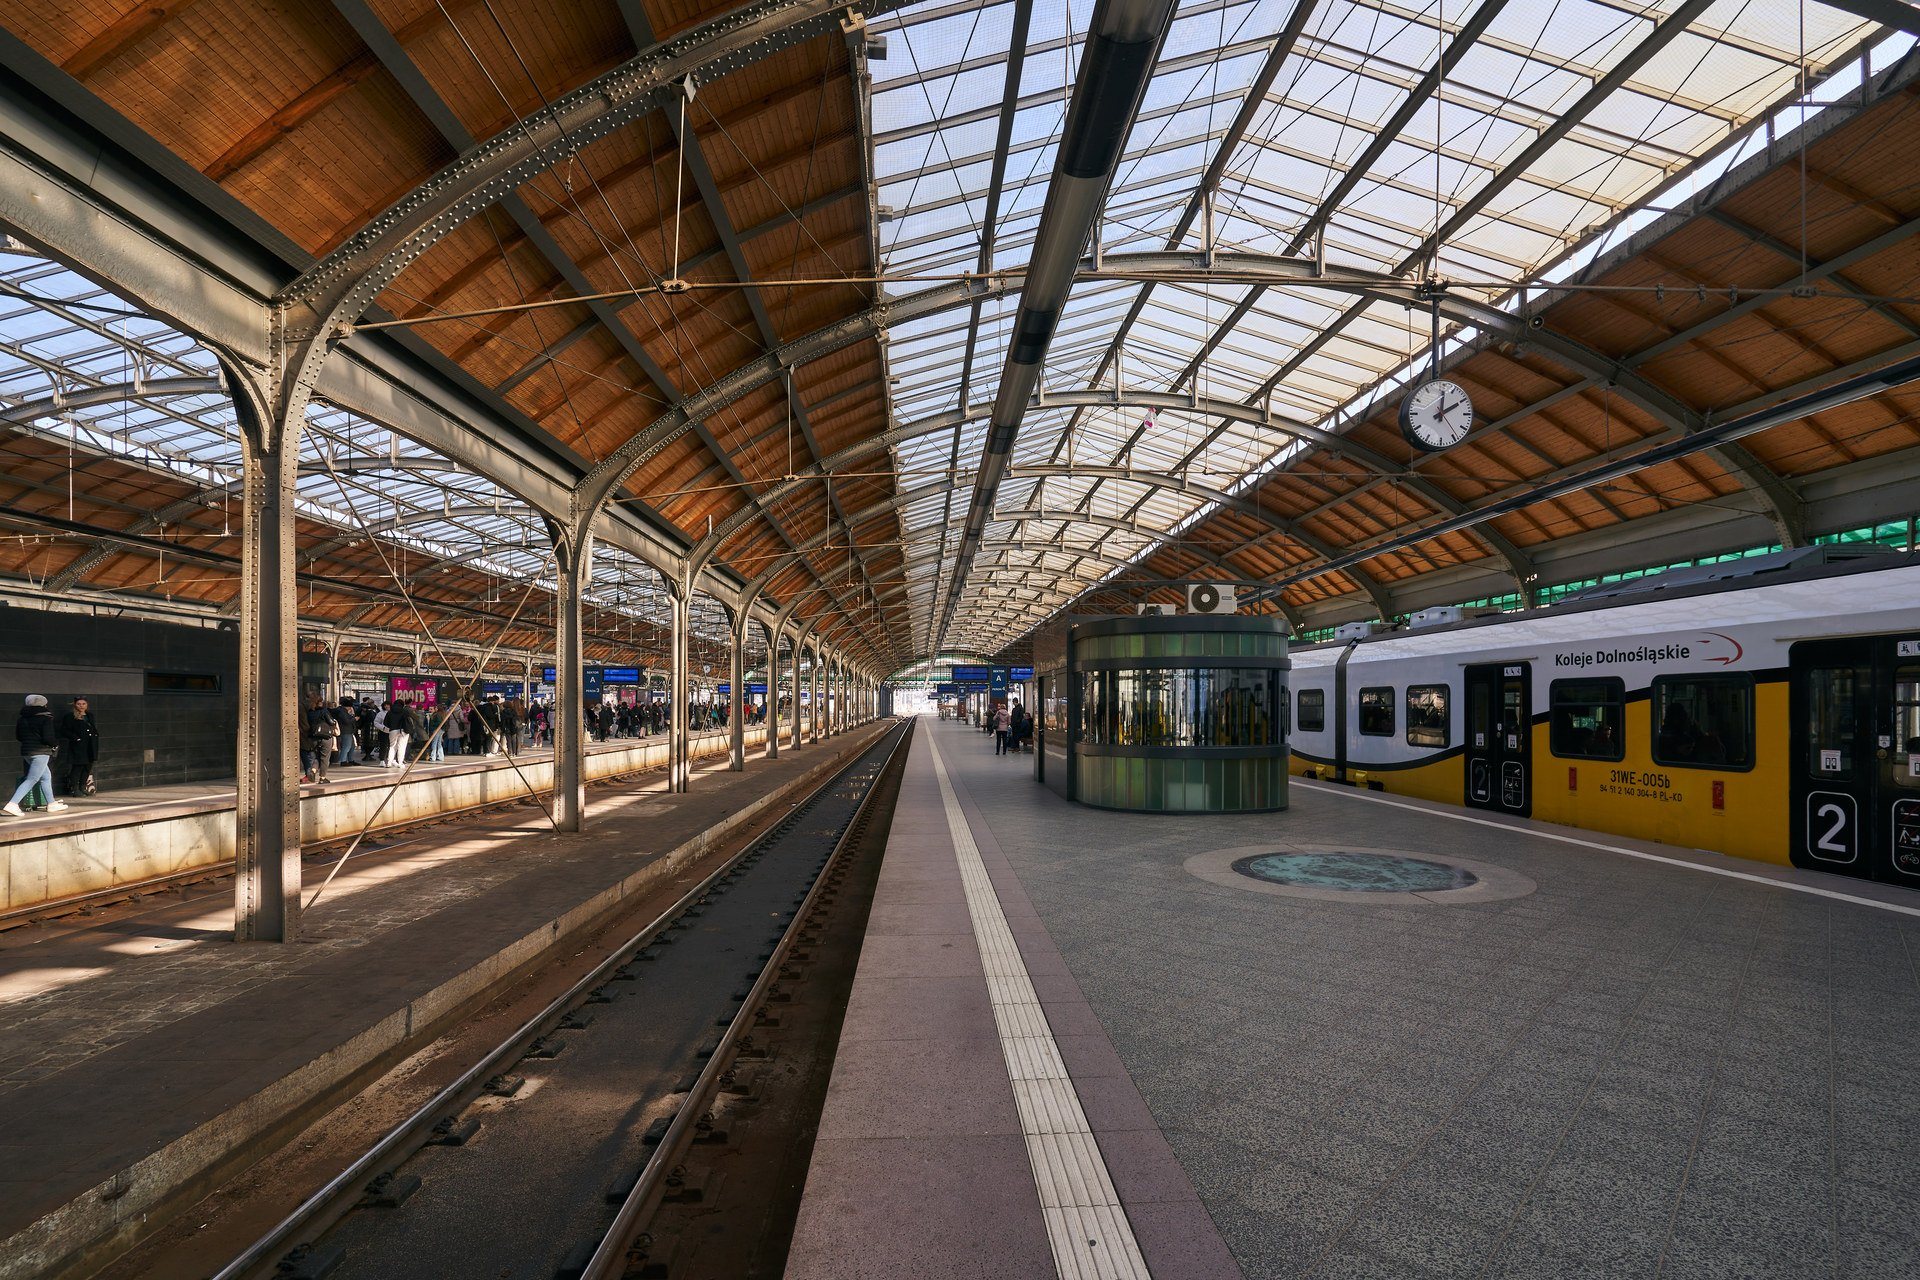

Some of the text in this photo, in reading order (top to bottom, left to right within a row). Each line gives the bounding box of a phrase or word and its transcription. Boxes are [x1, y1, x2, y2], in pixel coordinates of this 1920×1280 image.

[1555, 644, 1690, 669] Koleje Dolnośląskie
[1610, 769, 1670, 788] 31WE-005b
[1600, 784, 1608, 792] 94
[1609, 785, 1616, 793] 51
[1618, 786, 1622, 794] 2
[1624, 787, 1634, 796] 140
[1659, 791, 1682, 802] PL-KD
[1817, 803, 1846, 853] 2
